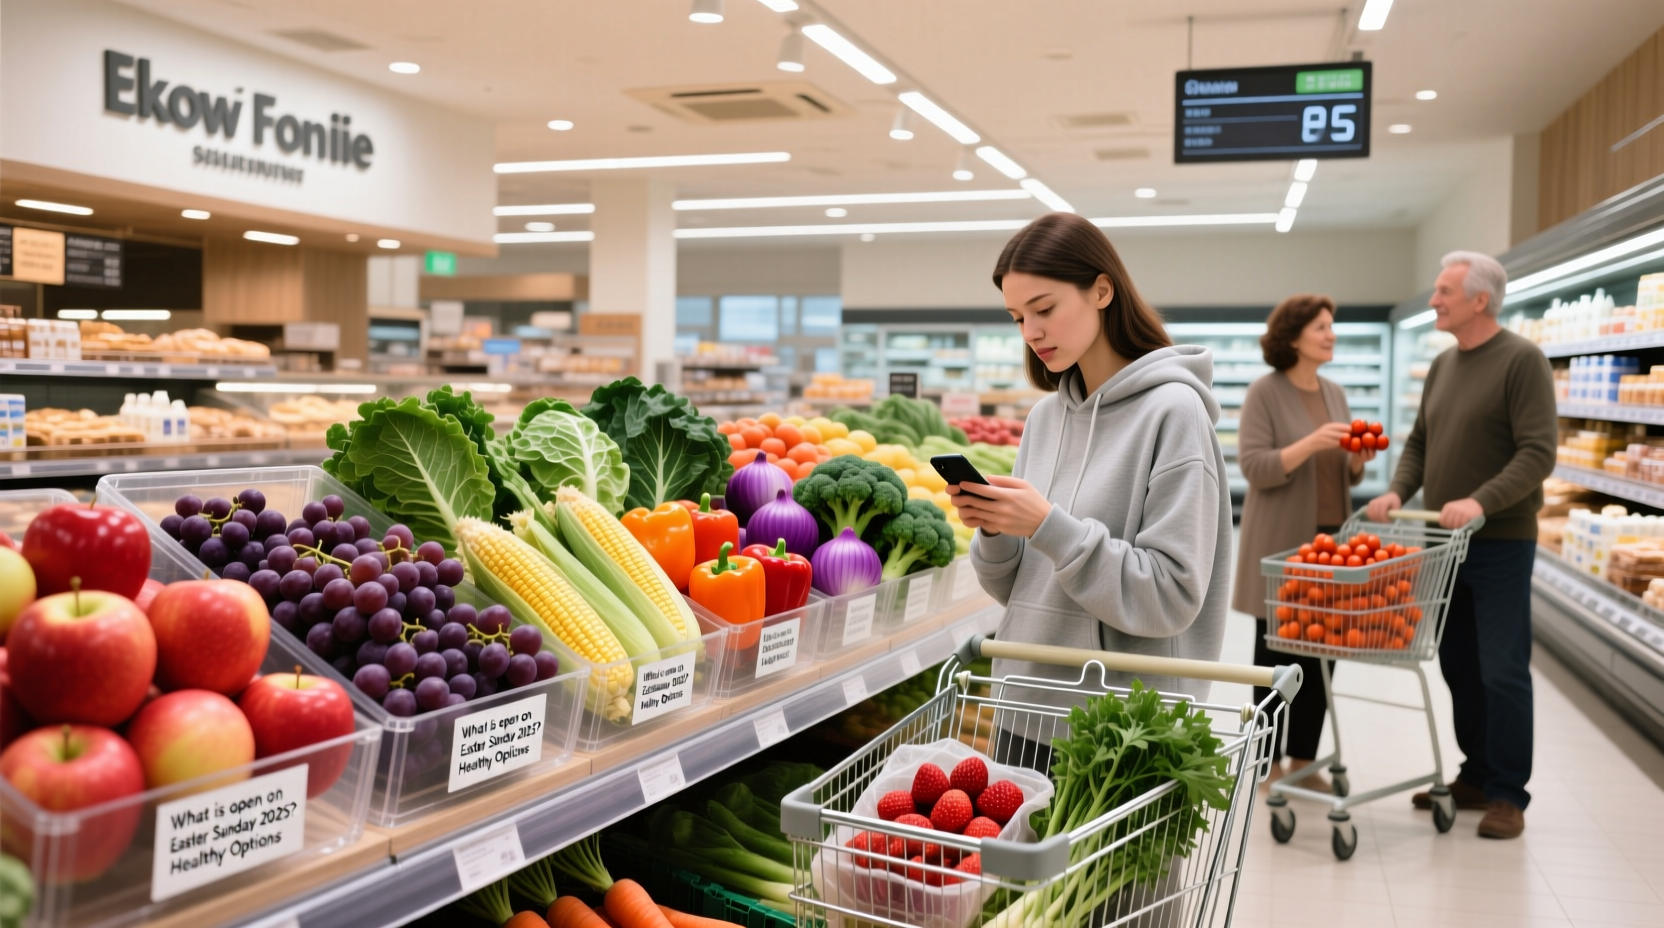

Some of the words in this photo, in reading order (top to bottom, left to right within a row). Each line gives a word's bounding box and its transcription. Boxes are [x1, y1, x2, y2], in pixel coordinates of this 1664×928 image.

[462, 721, 488, 739] What
[170, 831, 209, 853] Easter
[212, 818, 257, 841] Sunday
[259, 801, 297, 826] 2025?
[171, 808, 209, 830] What
[214, 802, 225, 817] is
[229, 795, 263, 814] open
[266, 789, 283, 803] on
[170, 847, 227, 875] Healthy
[230, 832, 282, 859] Options
